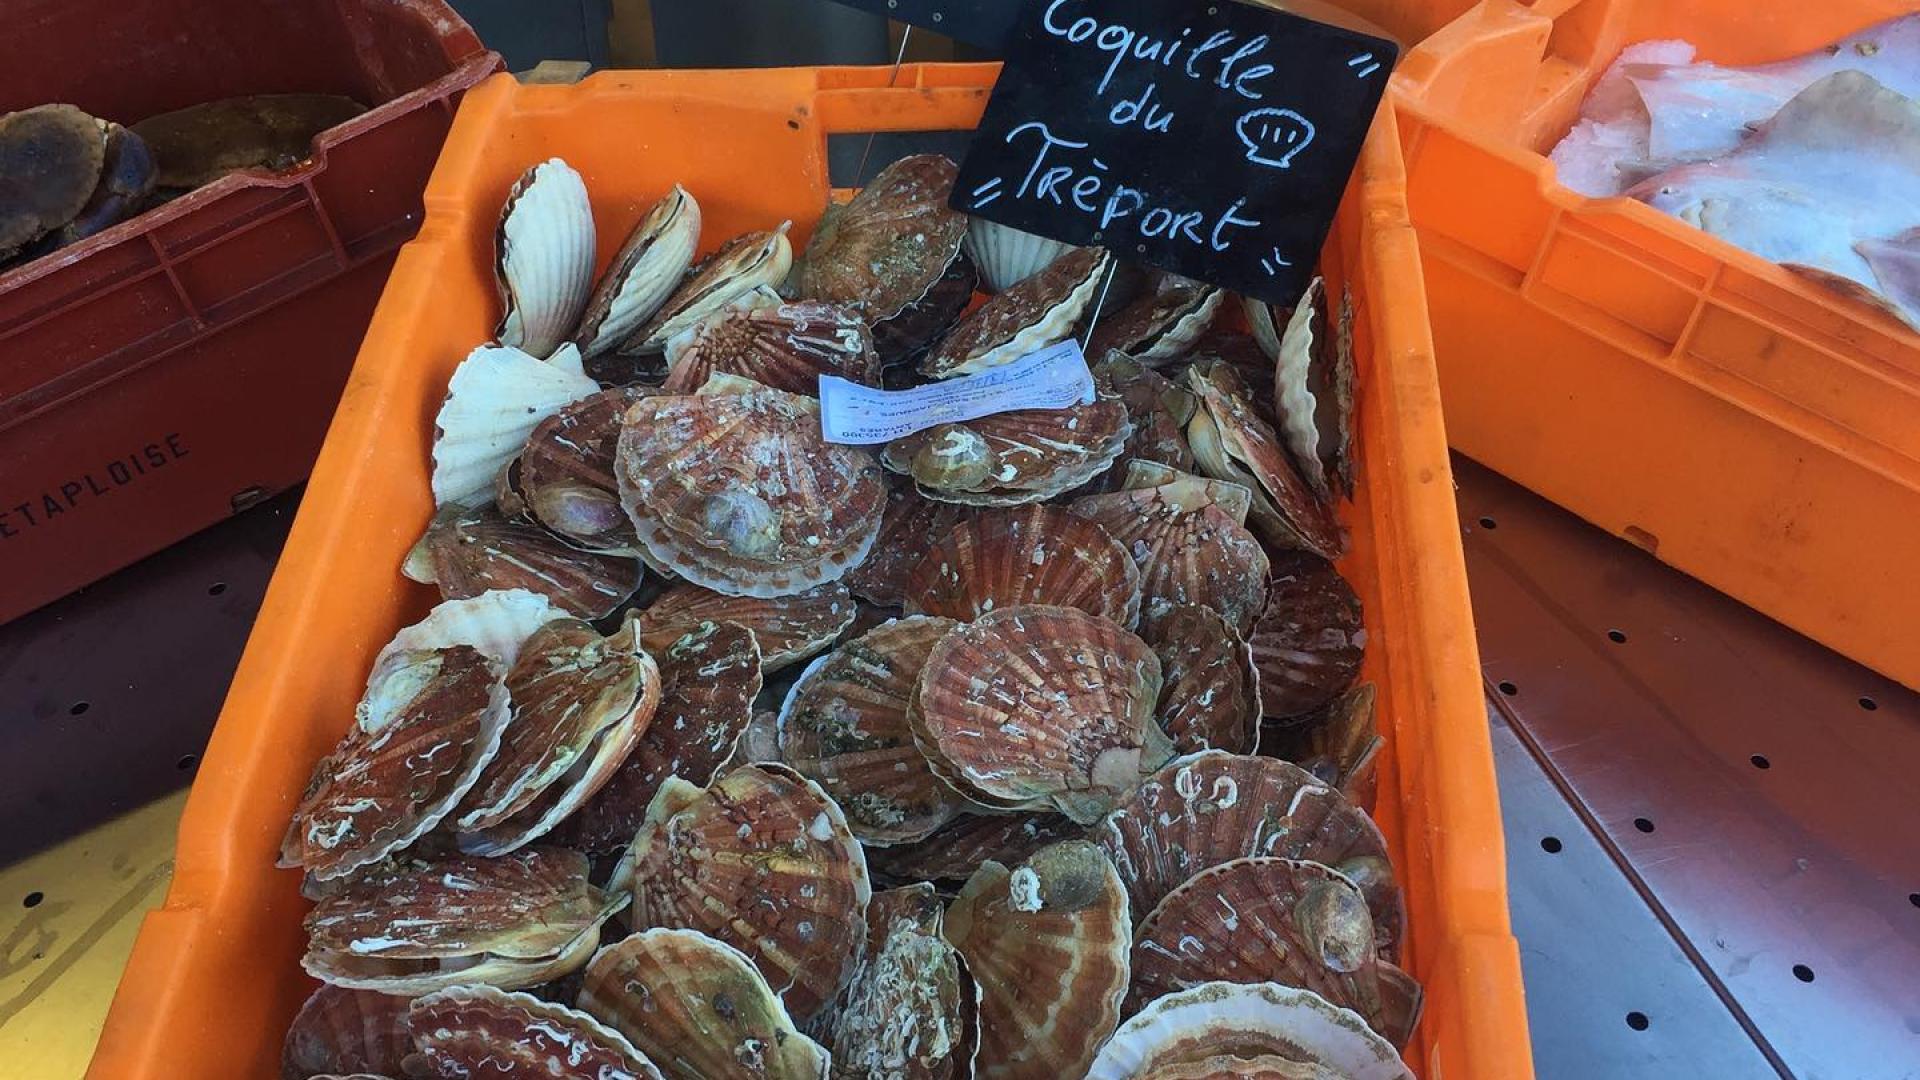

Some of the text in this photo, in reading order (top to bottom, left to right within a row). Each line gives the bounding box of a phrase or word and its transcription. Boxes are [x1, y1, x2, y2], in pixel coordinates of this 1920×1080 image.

[1042, 0, 1278, 99] Coquille
[1108, 83, 1175, 133] du
[0, 432, 190, 538] ETAPLOISE
